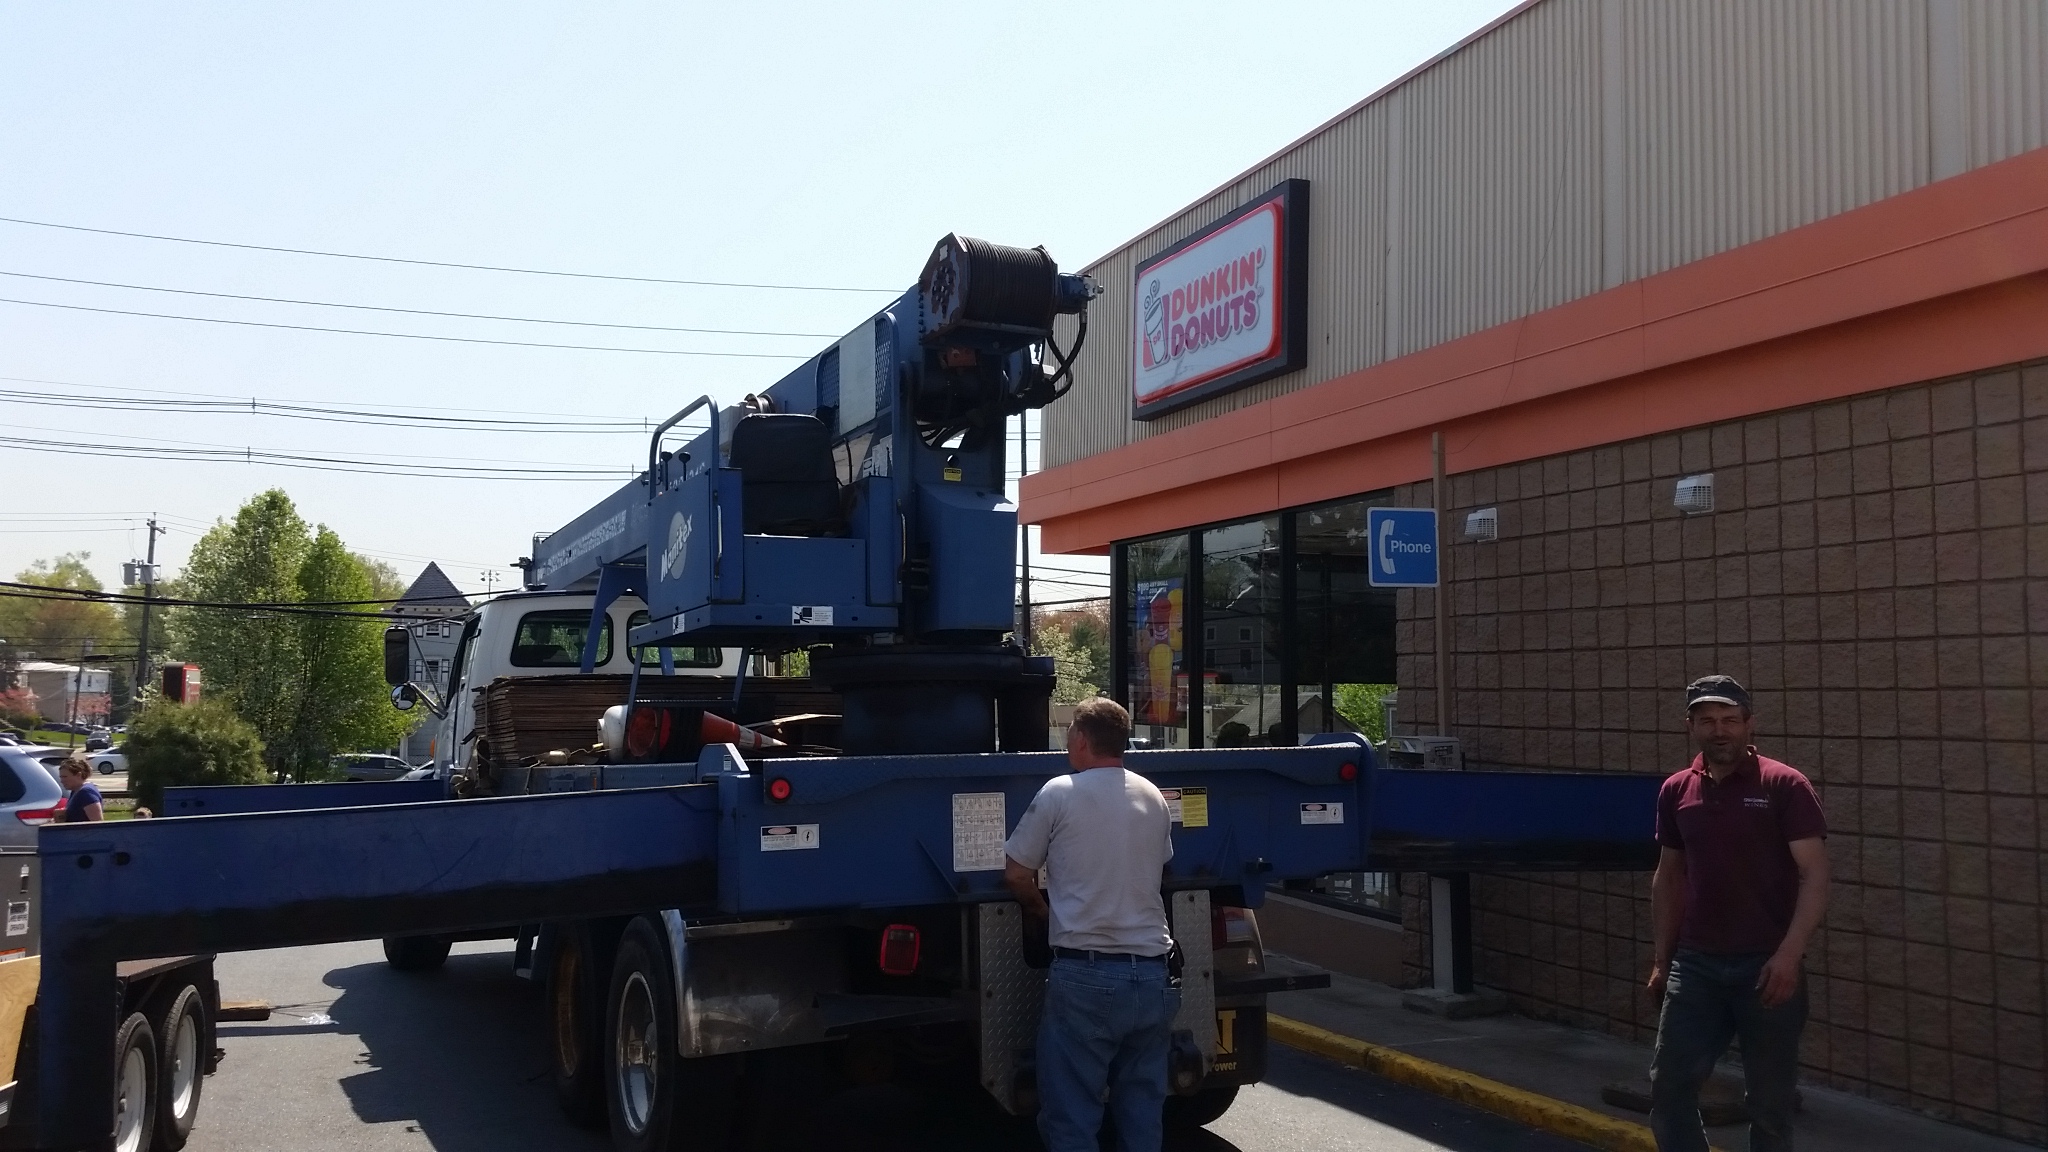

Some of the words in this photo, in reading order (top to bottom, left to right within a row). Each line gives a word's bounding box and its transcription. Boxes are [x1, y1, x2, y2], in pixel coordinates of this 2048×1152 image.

[1171, 247, 1263, 322] DUNKIN'
[1171, 289, 1257, 357] DONUTS
[661, 513, 693, 583] Manitex
[1390, 540, 1432, 553] Phone
